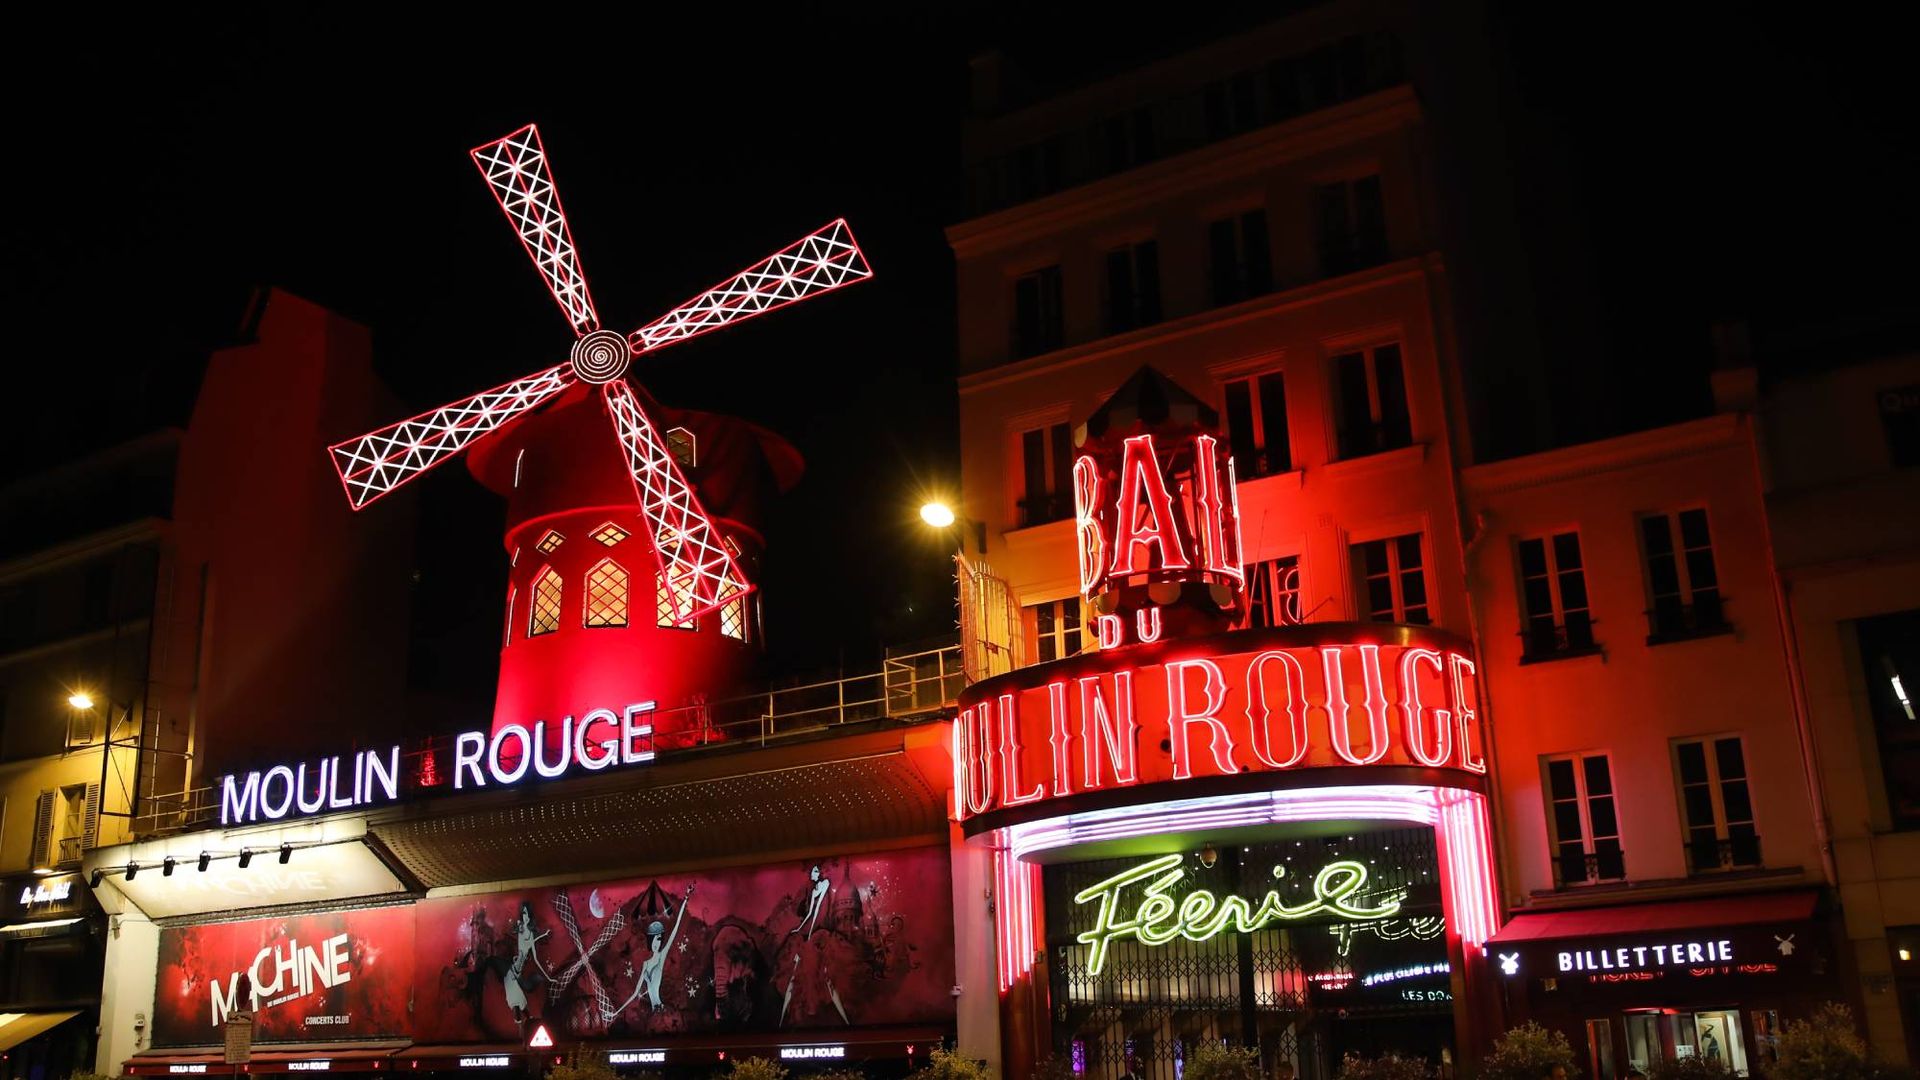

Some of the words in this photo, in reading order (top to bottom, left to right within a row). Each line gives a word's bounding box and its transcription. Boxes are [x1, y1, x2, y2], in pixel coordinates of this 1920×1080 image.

[1073, 434, 1246, 603] BAL
[1099, 607, 1161, 650] DU
[1166, 644, 1487, 780] ROUGE
[220, 744, 401, 825] MOULIN
[453, 700, 657, 790] ROUGE
[1075, 853, 1401, 976] Féerie
[1558, 940, 1733, 972] BILLETTERIE
[305, 1016, 334, 1025] CONCERTS
[334, 1015, 350, 1024] CLUB
[781, 1049, 813, 1058] MOULIN
[815, 1047, 845, 1057] ROUGE
